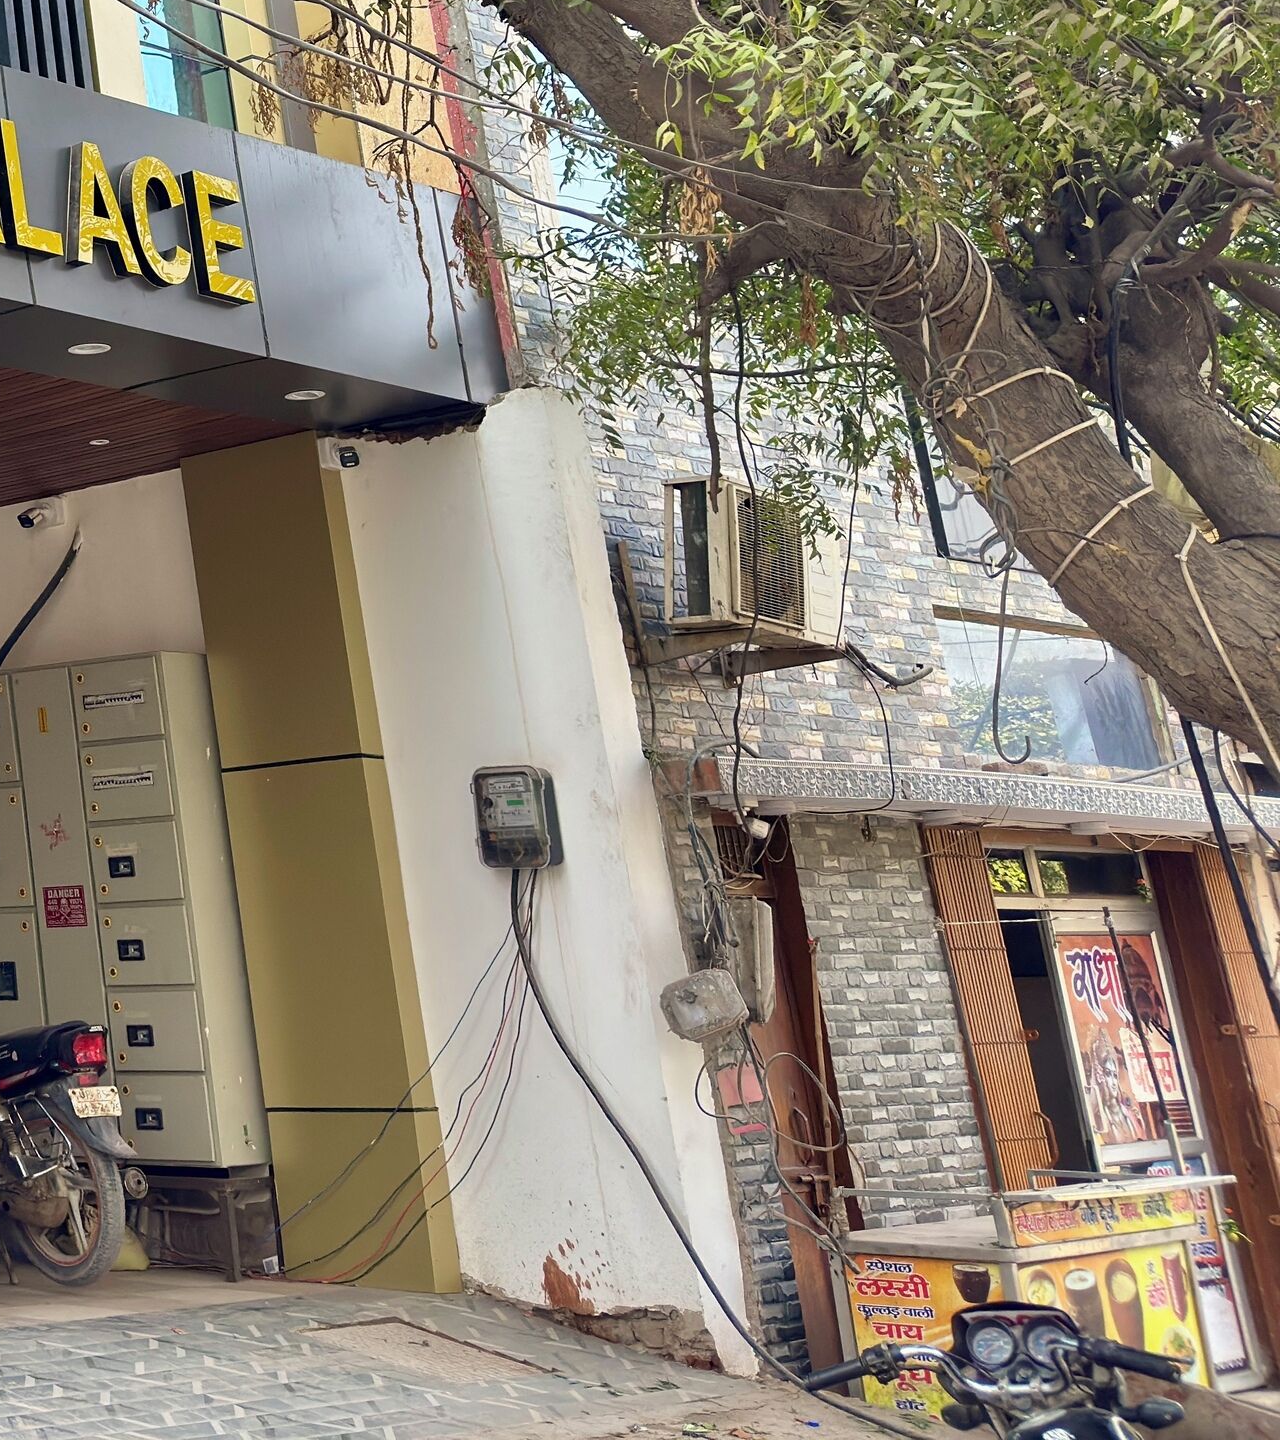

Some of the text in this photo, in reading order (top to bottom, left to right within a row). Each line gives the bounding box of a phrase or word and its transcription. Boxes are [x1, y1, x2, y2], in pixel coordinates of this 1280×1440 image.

[47, 888, 80, 898] DANGER
[1066, 948, 1129, 1018] राधा
[865, 1259, 913, 1273] स्पेशल
[854, 1274, 930, 1298] लस्सी
[857, 1304, 934, 1318] कुल्लड़ वाली
[872, 1322, 924, 1340] चाय
